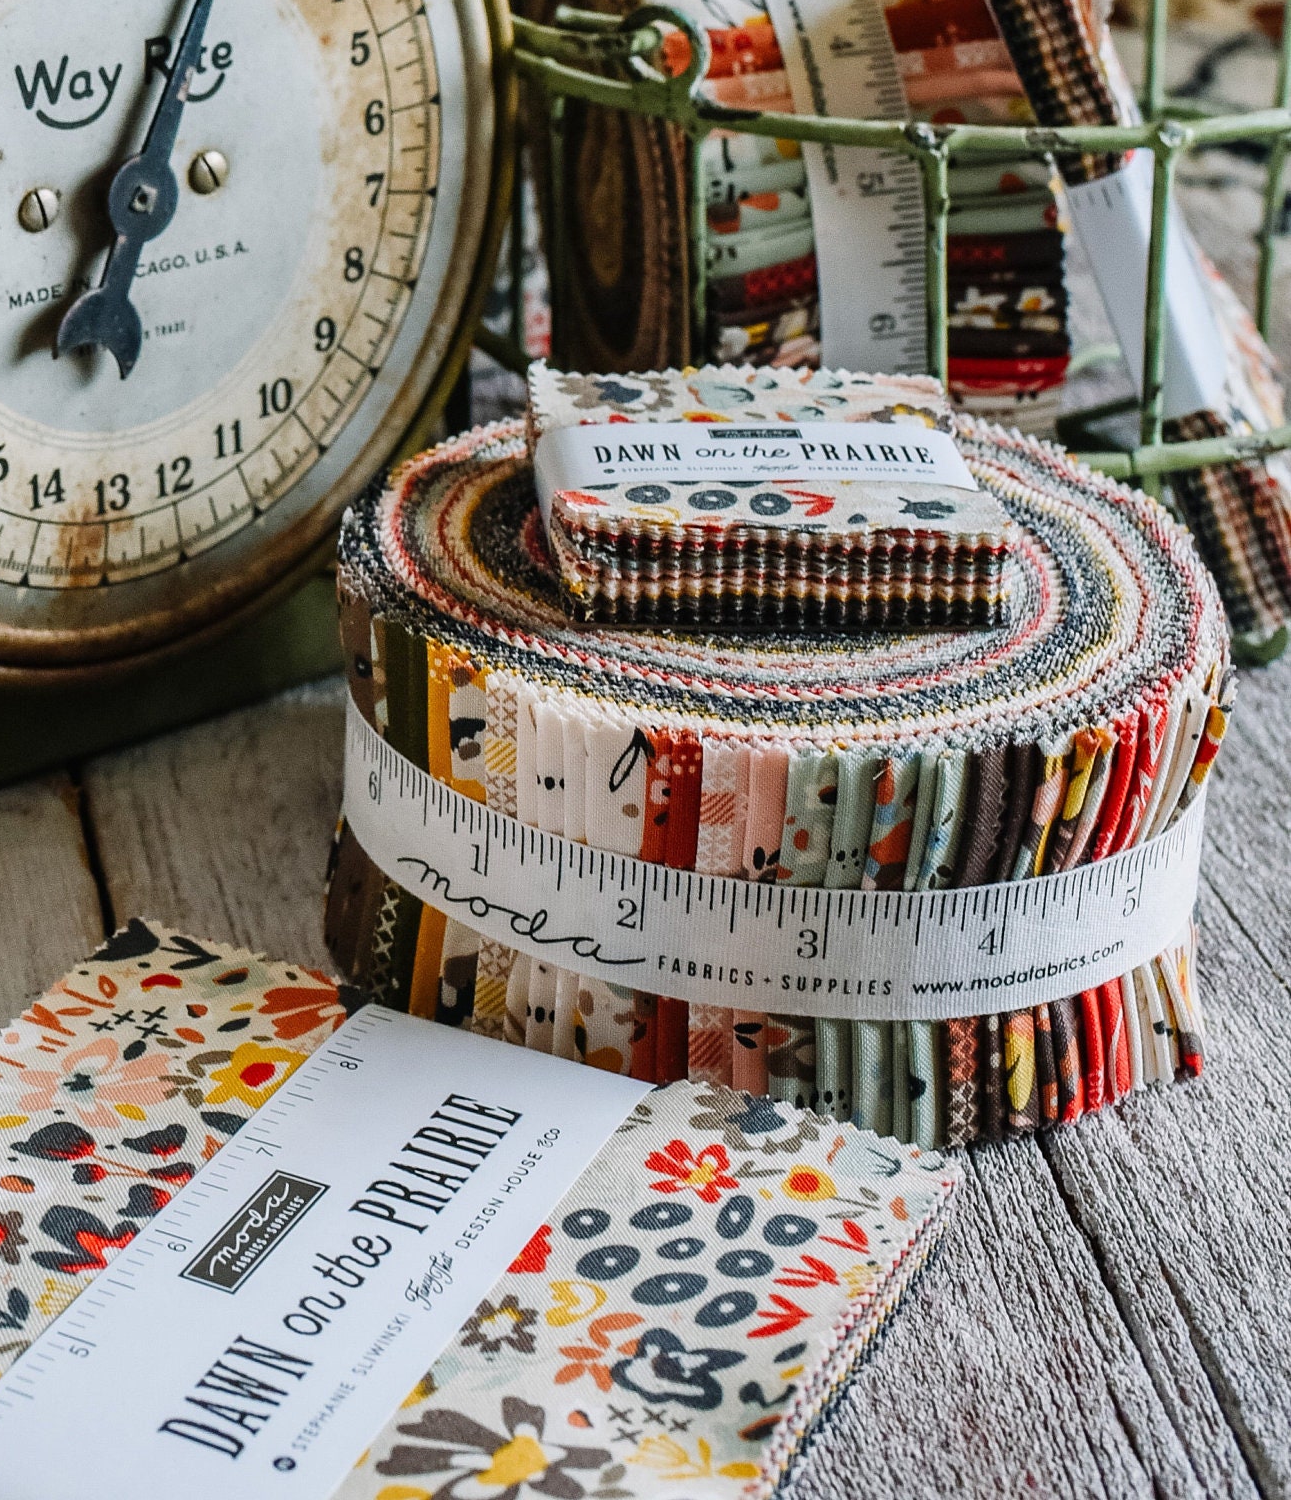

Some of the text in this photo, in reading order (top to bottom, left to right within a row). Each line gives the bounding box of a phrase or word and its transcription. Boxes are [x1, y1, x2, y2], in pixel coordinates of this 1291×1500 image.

[349, 31, 371, 68] 5
[15, 35, 234, 130] Way Rte
[364, 100, 386, 136] 6
[364, 172, 386, 208] 7
[858, 172, 884, 193] 5
[8, 283, 63, 310] MADE
[135, 254, 190, 278] CAGO,
[342, 246, 366, 284] 8
[313, 316, 336, 353] 9
[257, 377, 293, 417] 10
[213, 419, 245, 459] 11
[593, 443, 936, 465] DAWN on the PRAIRIE
[28, 466, 65, 510] 14
[94, 475, 133, 515] 13
[154, 455, 194, 498] 12
[368, 770, 378, 800] 6
[617, 898, 638, 929] 2
[1121, 886, 1137, 918] 5
[397, 856, 646, 965] moda
[657, 954, 755, 988] FABRICS
[780, 973, 893, 997] SUPPLIES
[912, 939, 1125, 996] www.modafabrics.com
[796, 928, 820, 960] 3
[977, 928, 998, 956] 4
[340, 1059, 359, 1071] 8
[256, 1146, 275, 1157] 7
[167, 1241, 187, 1253] 6
[209, 1182, 290, 1276] moda
[231, 1237, 267, 1274] FABRICS
[266, 1195, 305, 1234] SUPPLIES
[157, 1092, 524, 1460] DAWN on the PRAIRIE
[291, 1381, 358, 1453] STEPHANIE
[359, 1312, 413, 1377] SLIWINSKI
[455, 1197, 505, 1250] DESIGN
[500, 1151, 543, 1194] HOUSE
[69, 1343, 89, 1358] 5
